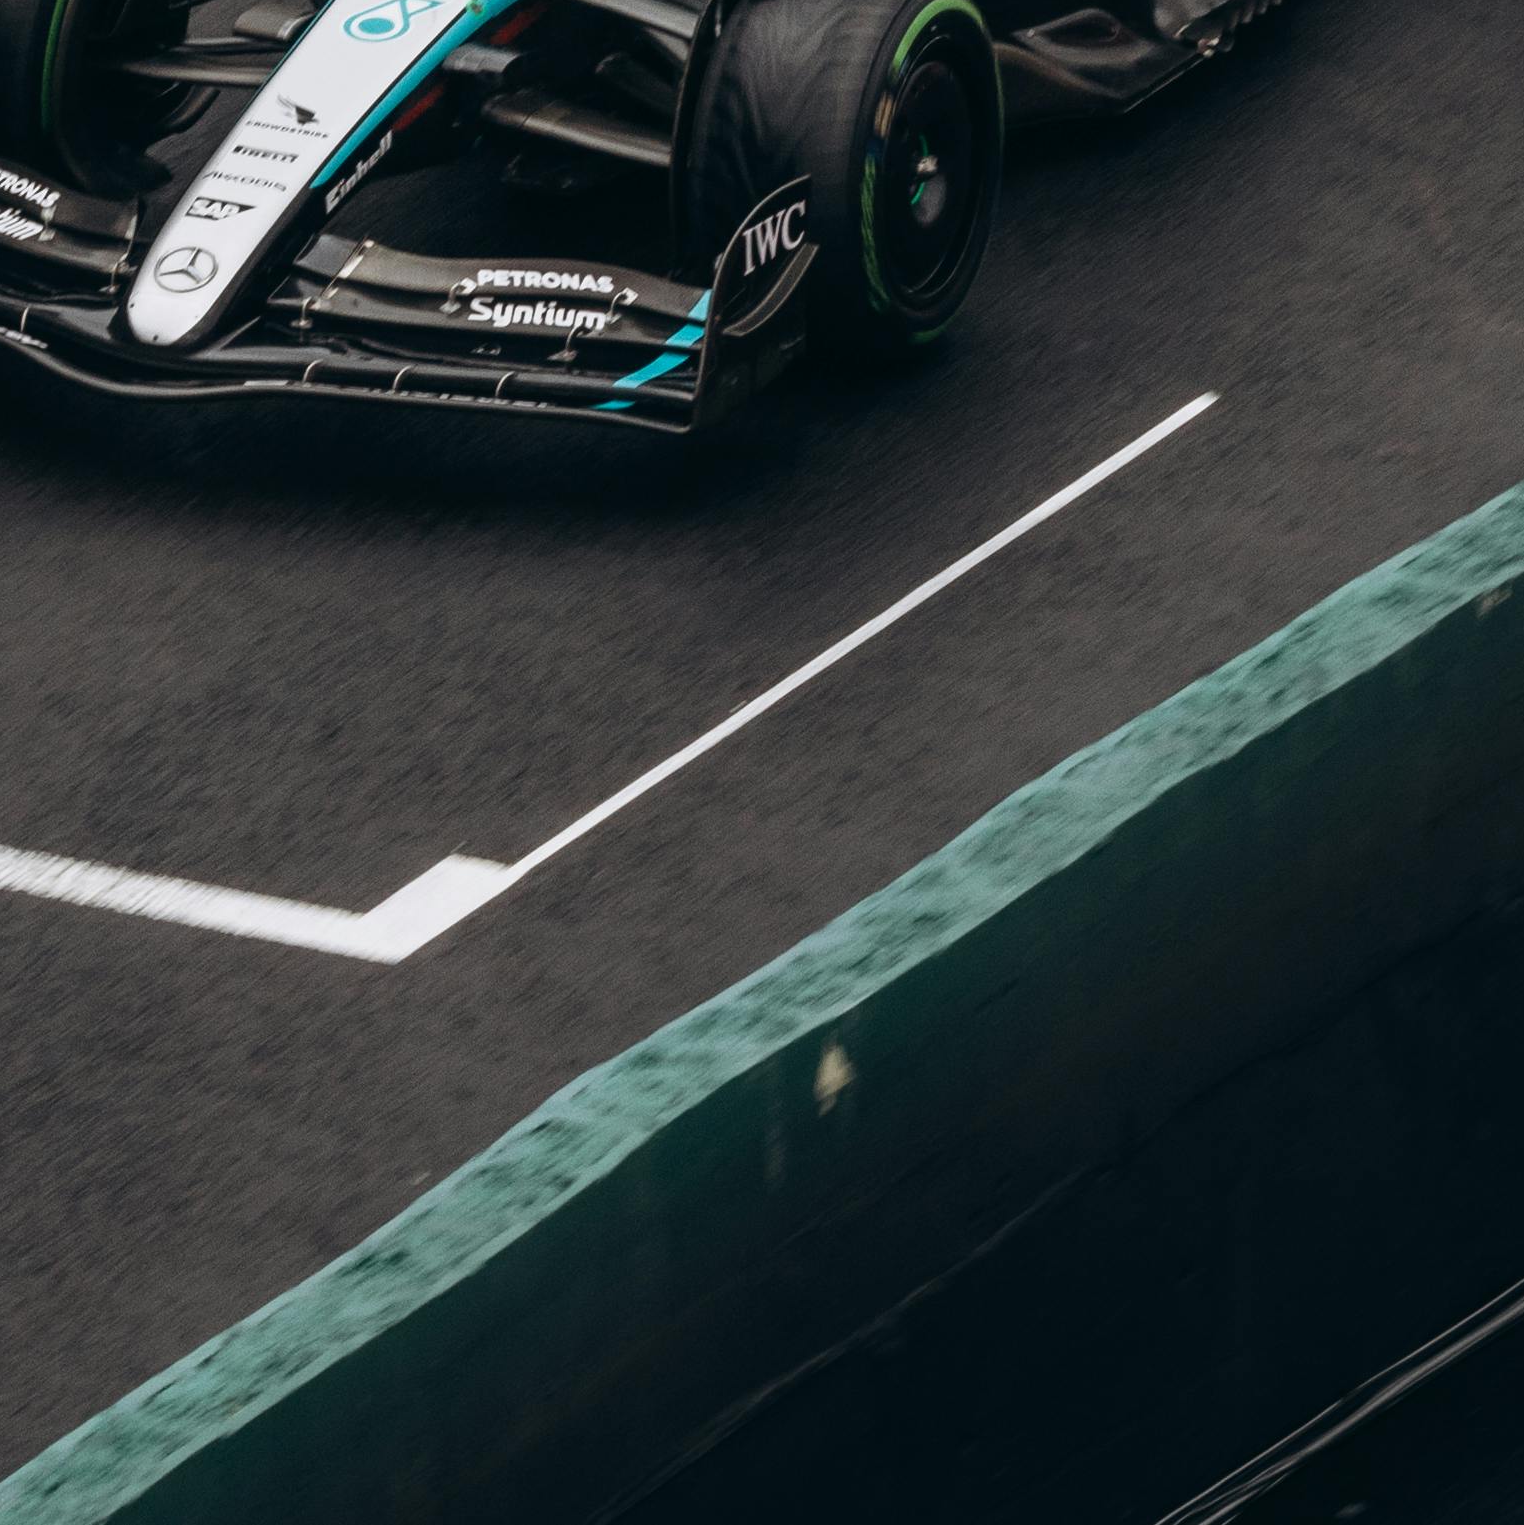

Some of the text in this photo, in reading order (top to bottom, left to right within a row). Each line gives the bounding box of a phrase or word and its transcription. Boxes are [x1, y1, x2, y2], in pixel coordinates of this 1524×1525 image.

[188, 198, 242, 219] SAP
[742, 199, 806, 276] IWC
[477, 269, 614, 293] PETRONAS
[467, 297, 607, 331] Syntium
